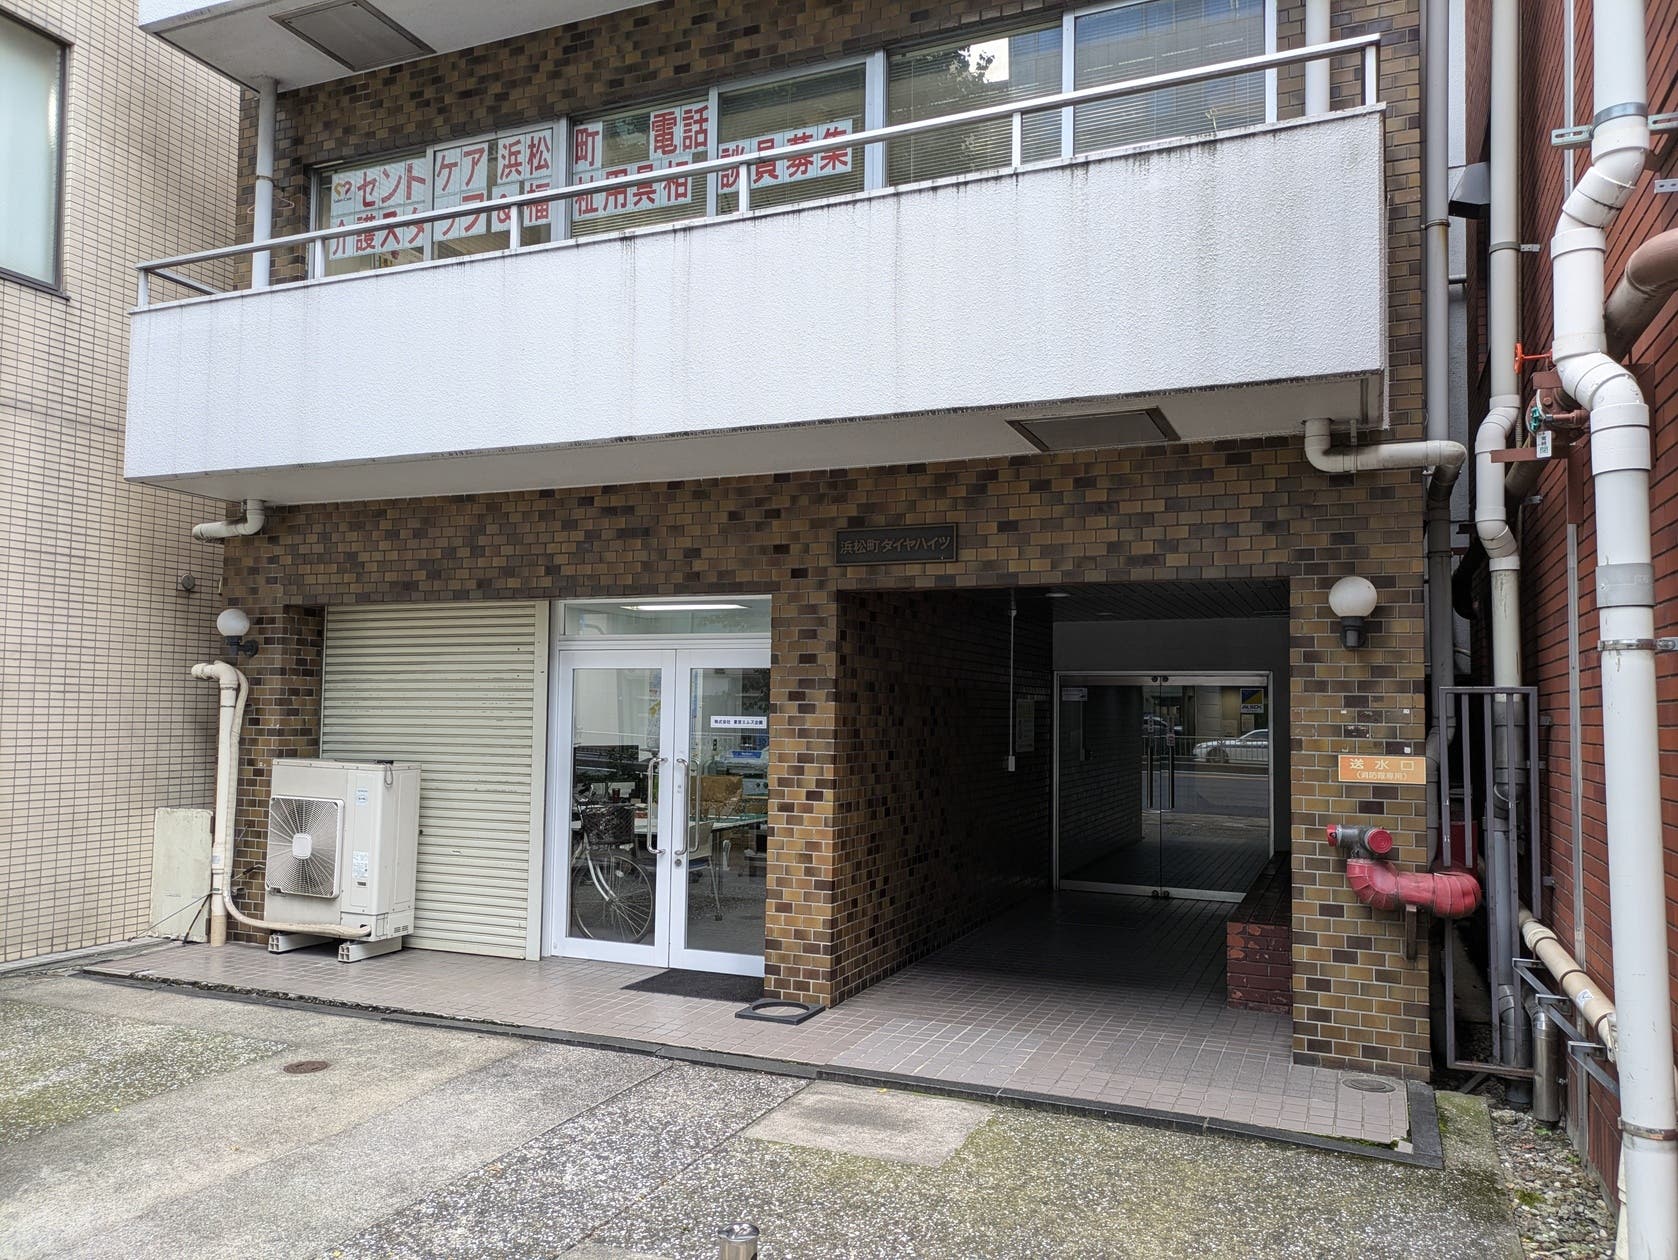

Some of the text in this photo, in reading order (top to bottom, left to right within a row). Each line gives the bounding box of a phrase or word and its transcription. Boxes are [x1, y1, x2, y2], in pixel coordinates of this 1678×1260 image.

[652, 105, 709, 155] 電話
[1349, 758, 1415, 771] 送水口
